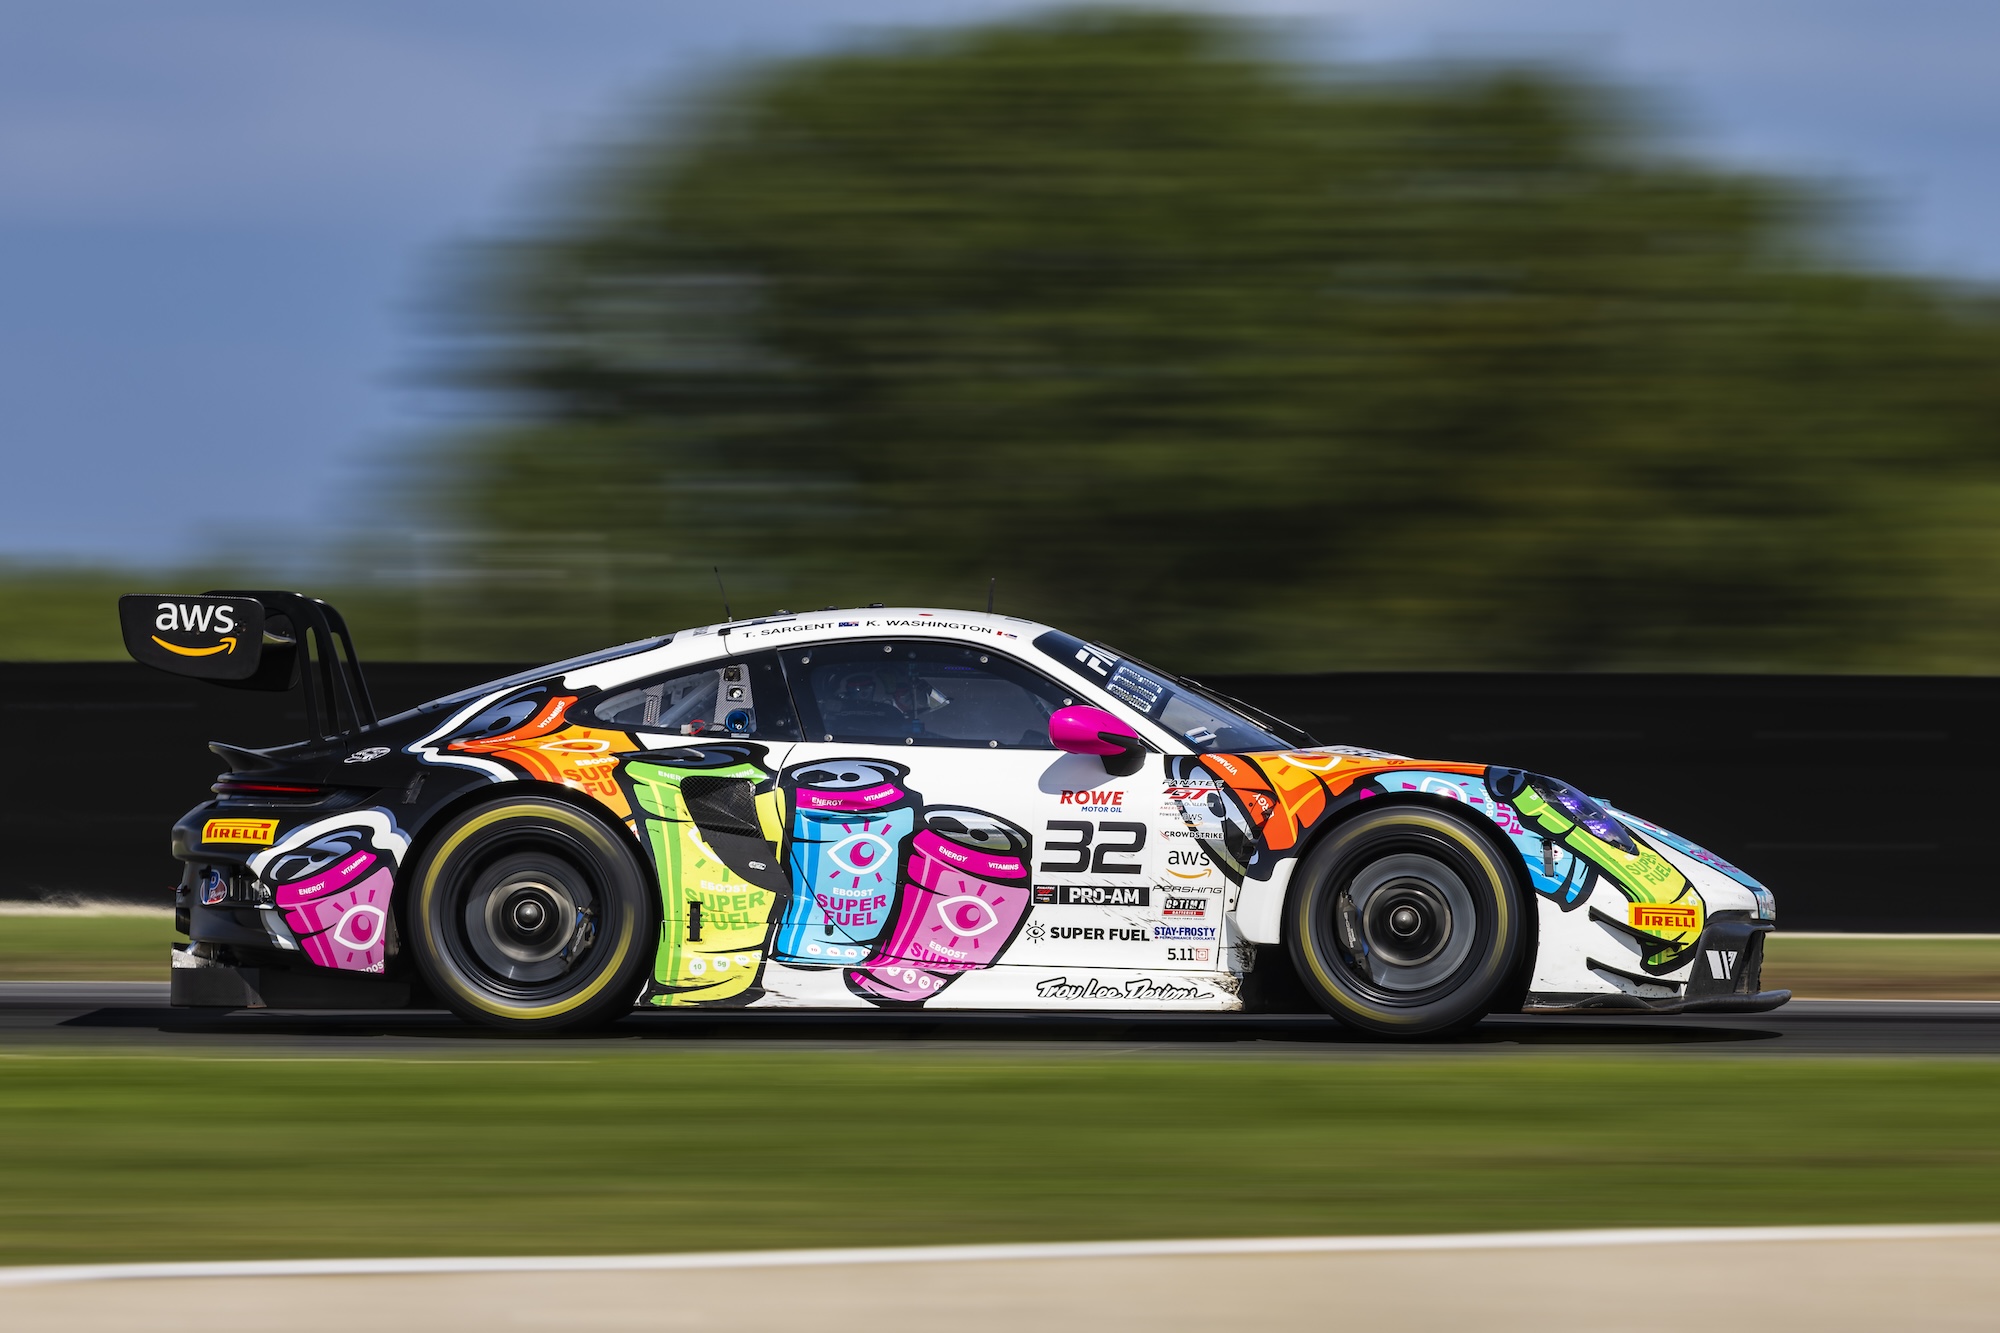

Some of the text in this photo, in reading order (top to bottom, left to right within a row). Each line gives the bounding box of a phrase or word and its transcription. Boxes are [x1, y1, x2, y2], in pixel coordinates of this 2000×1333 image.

[156, 603, 234, 633] aws
[761, 622, 835, 636] SARGENT
[886, 620, 992, 634] WASHINGTON
[537, 700, 566, 728] VITAMINS
[658, 770, 685, 782] ENER
[811, 788, 895, 807] ENERGY VITAMINS
[1060, 789, 1124, 805] ROWE
[206, 822, 271, 840] PIRELLI
[1164, 830, 1224, 839] CROWDSTRIKE
[1040, 820, 1147, 874] 32
[938, 845, 1019, 871] ENERGY VITAMINS
[1168, 849, 1210, 866] aws
[1625, 852, 1656, 875] SUPER
[298, 854, 367, 896] ENERGY VITAMINS
[1644, 863, 1671, 885] FUEL
[700, 880, 748, 893] EBOOST
[832, 887, 874, 897] EBOOST
[685, 887, 765, 912] SUPER
[816, 893, 887, 912] SUPER
[1069, 887, 1140, 905] PRO-AM
[823, 909, 878, 927] FUEL
[1634, 907, 1696, 928] PIRELLI
[1050, 926, 1150, 942] SUPER FUEL
[928, 940, 968, 960] EBOOST
[1167, 948, 1194, 961] 5.11
